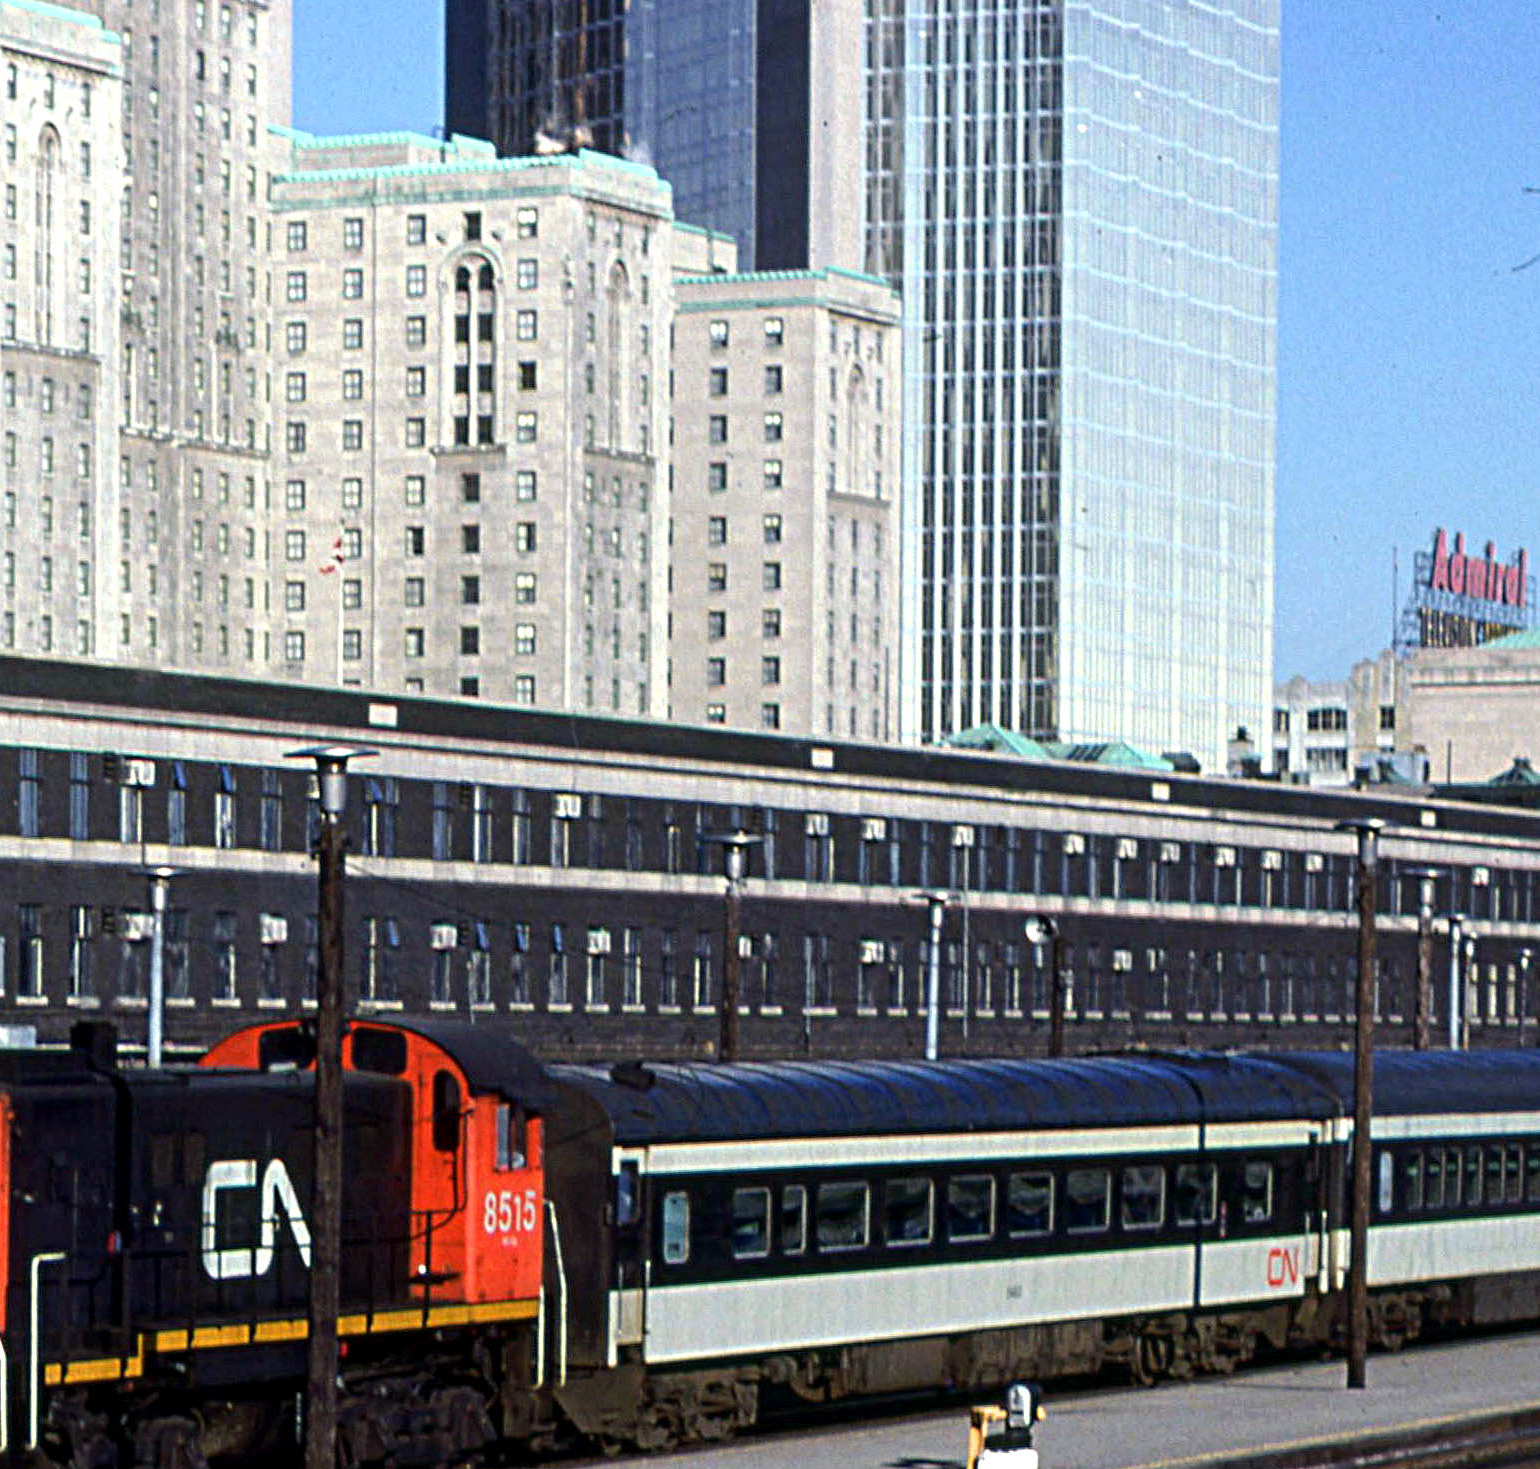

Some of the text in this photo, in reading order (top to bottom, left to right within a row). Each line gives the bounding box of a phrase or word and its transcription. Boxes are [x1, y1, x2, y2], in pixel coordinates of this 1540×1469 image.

[1429, 527, 1528, 609] Admiral
[201, 1158, 312, 1280] CN
[484, 1189, 537, 1234] 8515
[1266, 1246, 1299, 1287] CN
